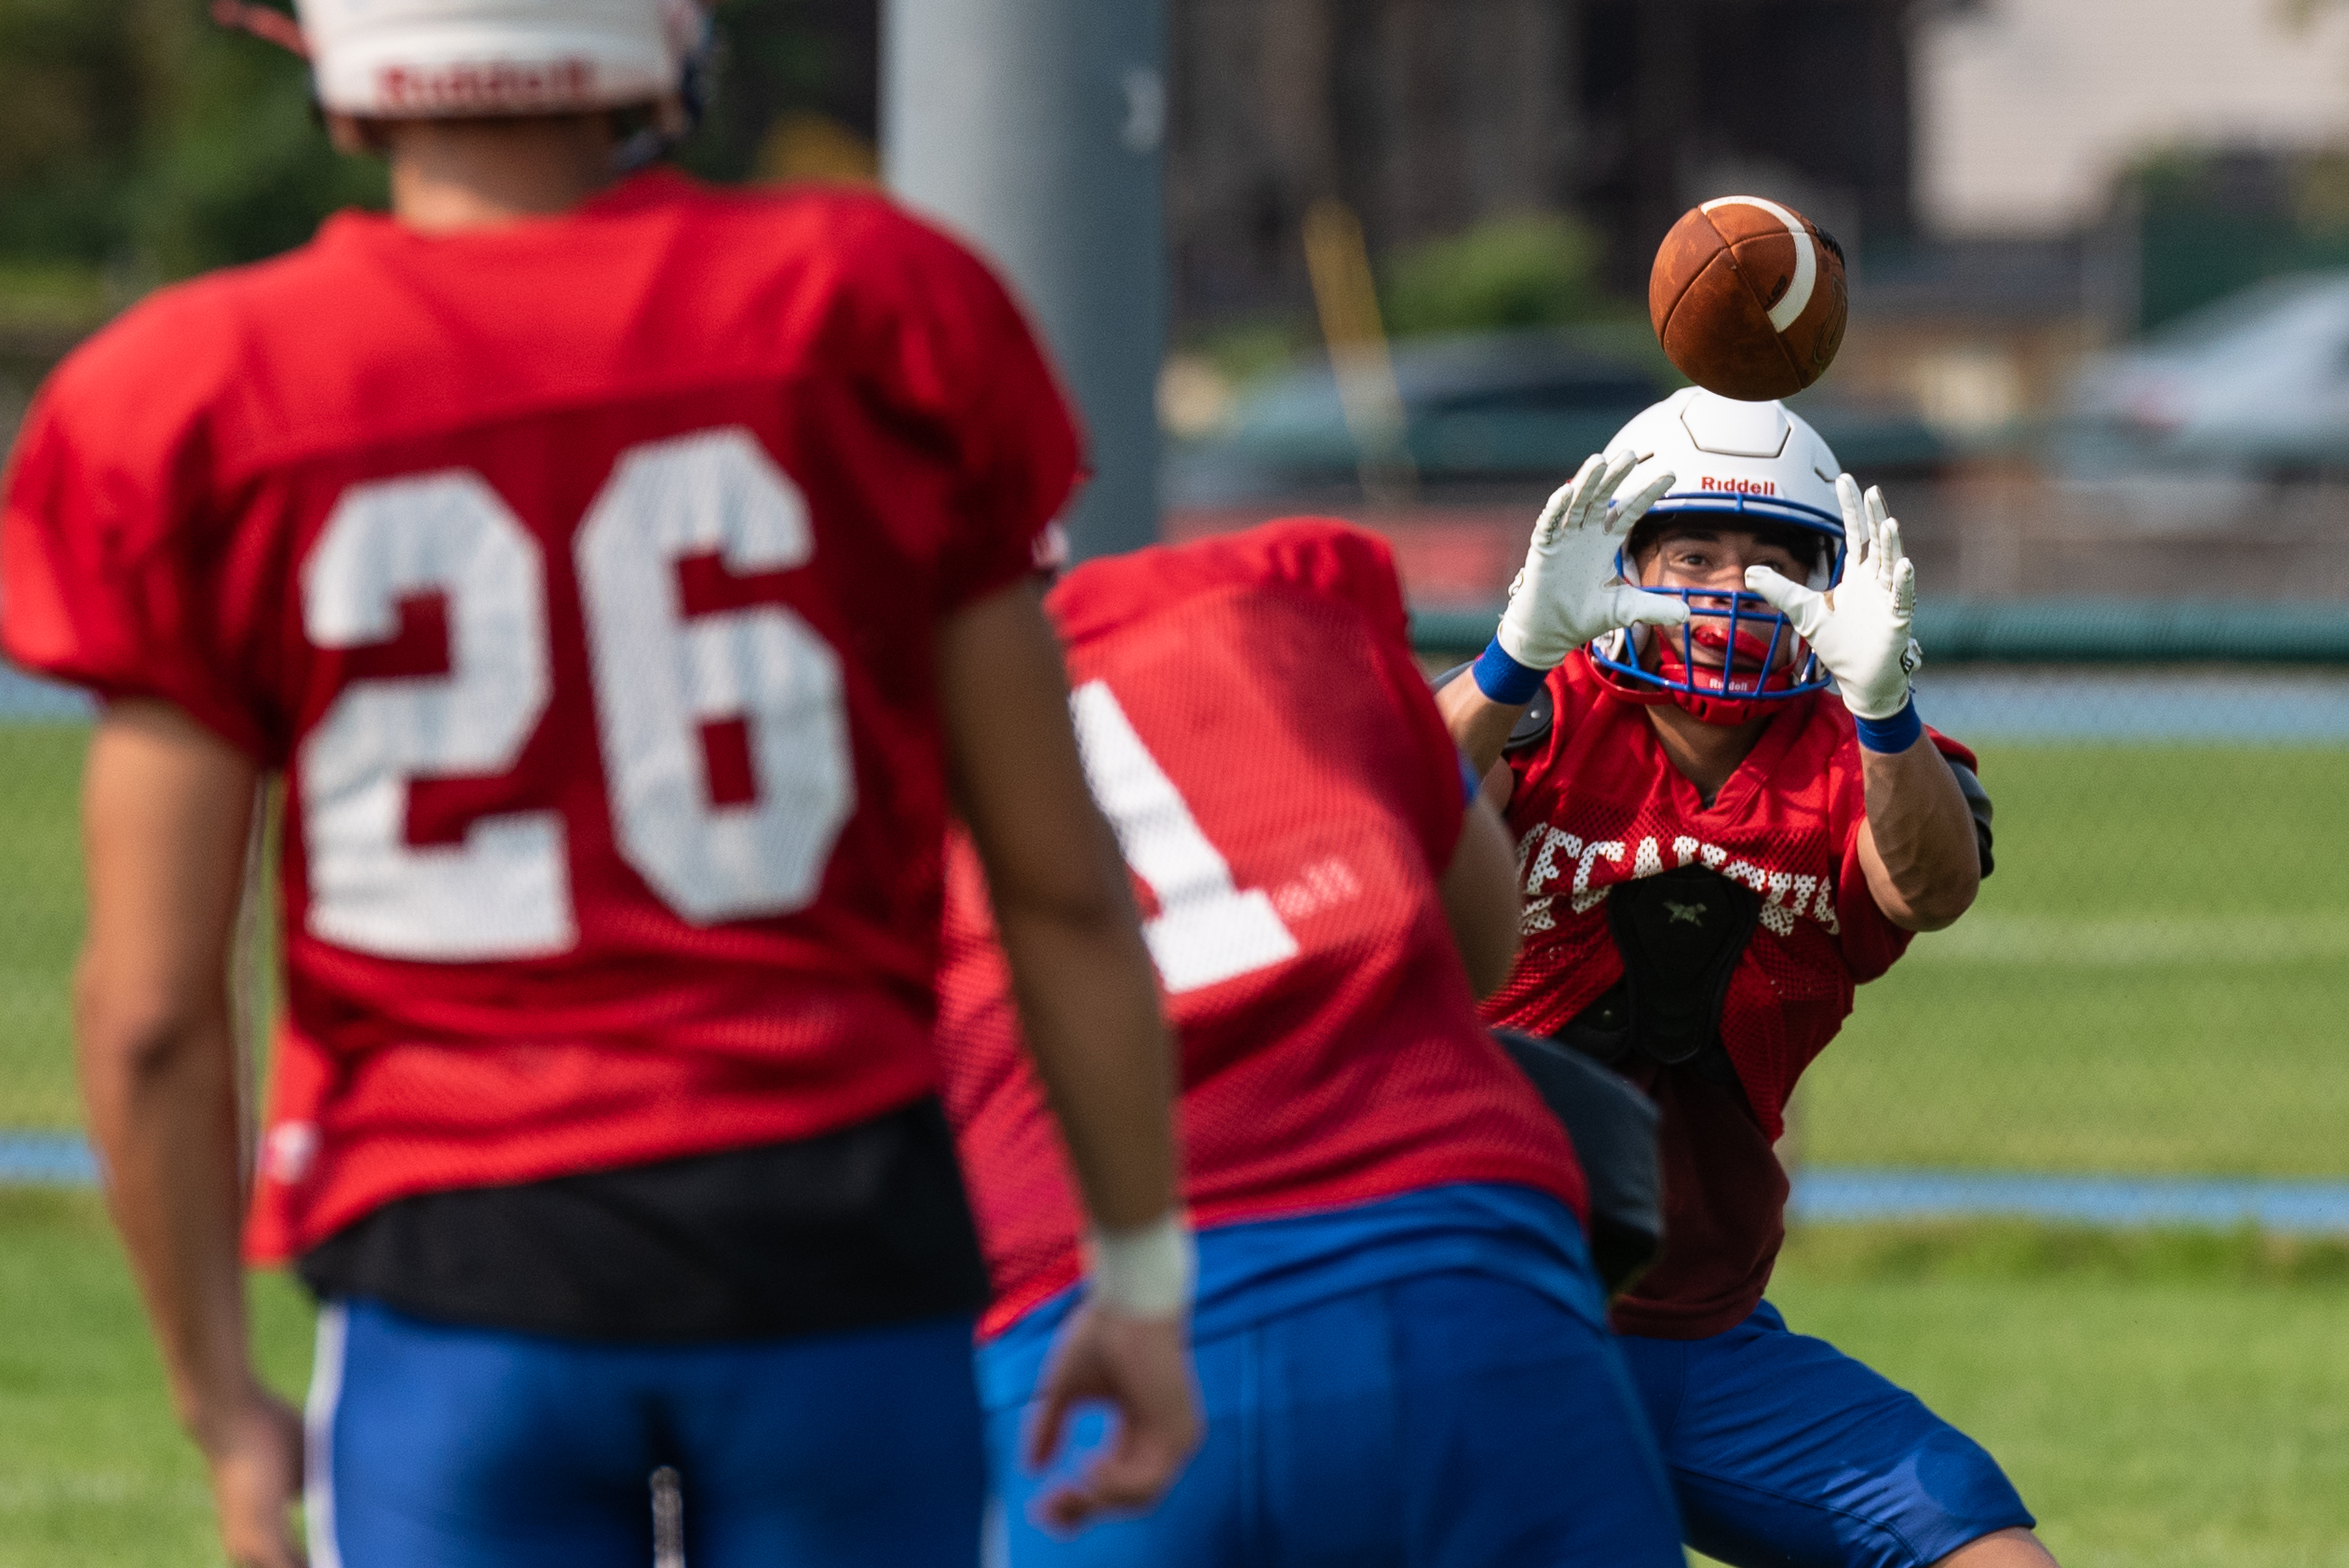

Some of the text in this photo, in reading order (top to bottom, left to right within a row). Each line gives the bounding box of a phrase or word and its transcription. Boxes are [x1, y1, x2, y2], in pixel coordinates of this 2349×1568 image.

[1701, 476, 1775, 495] Riddell
[298, 425, 858, 963] 26
[1708, 677, 1748, 693] Ridell
